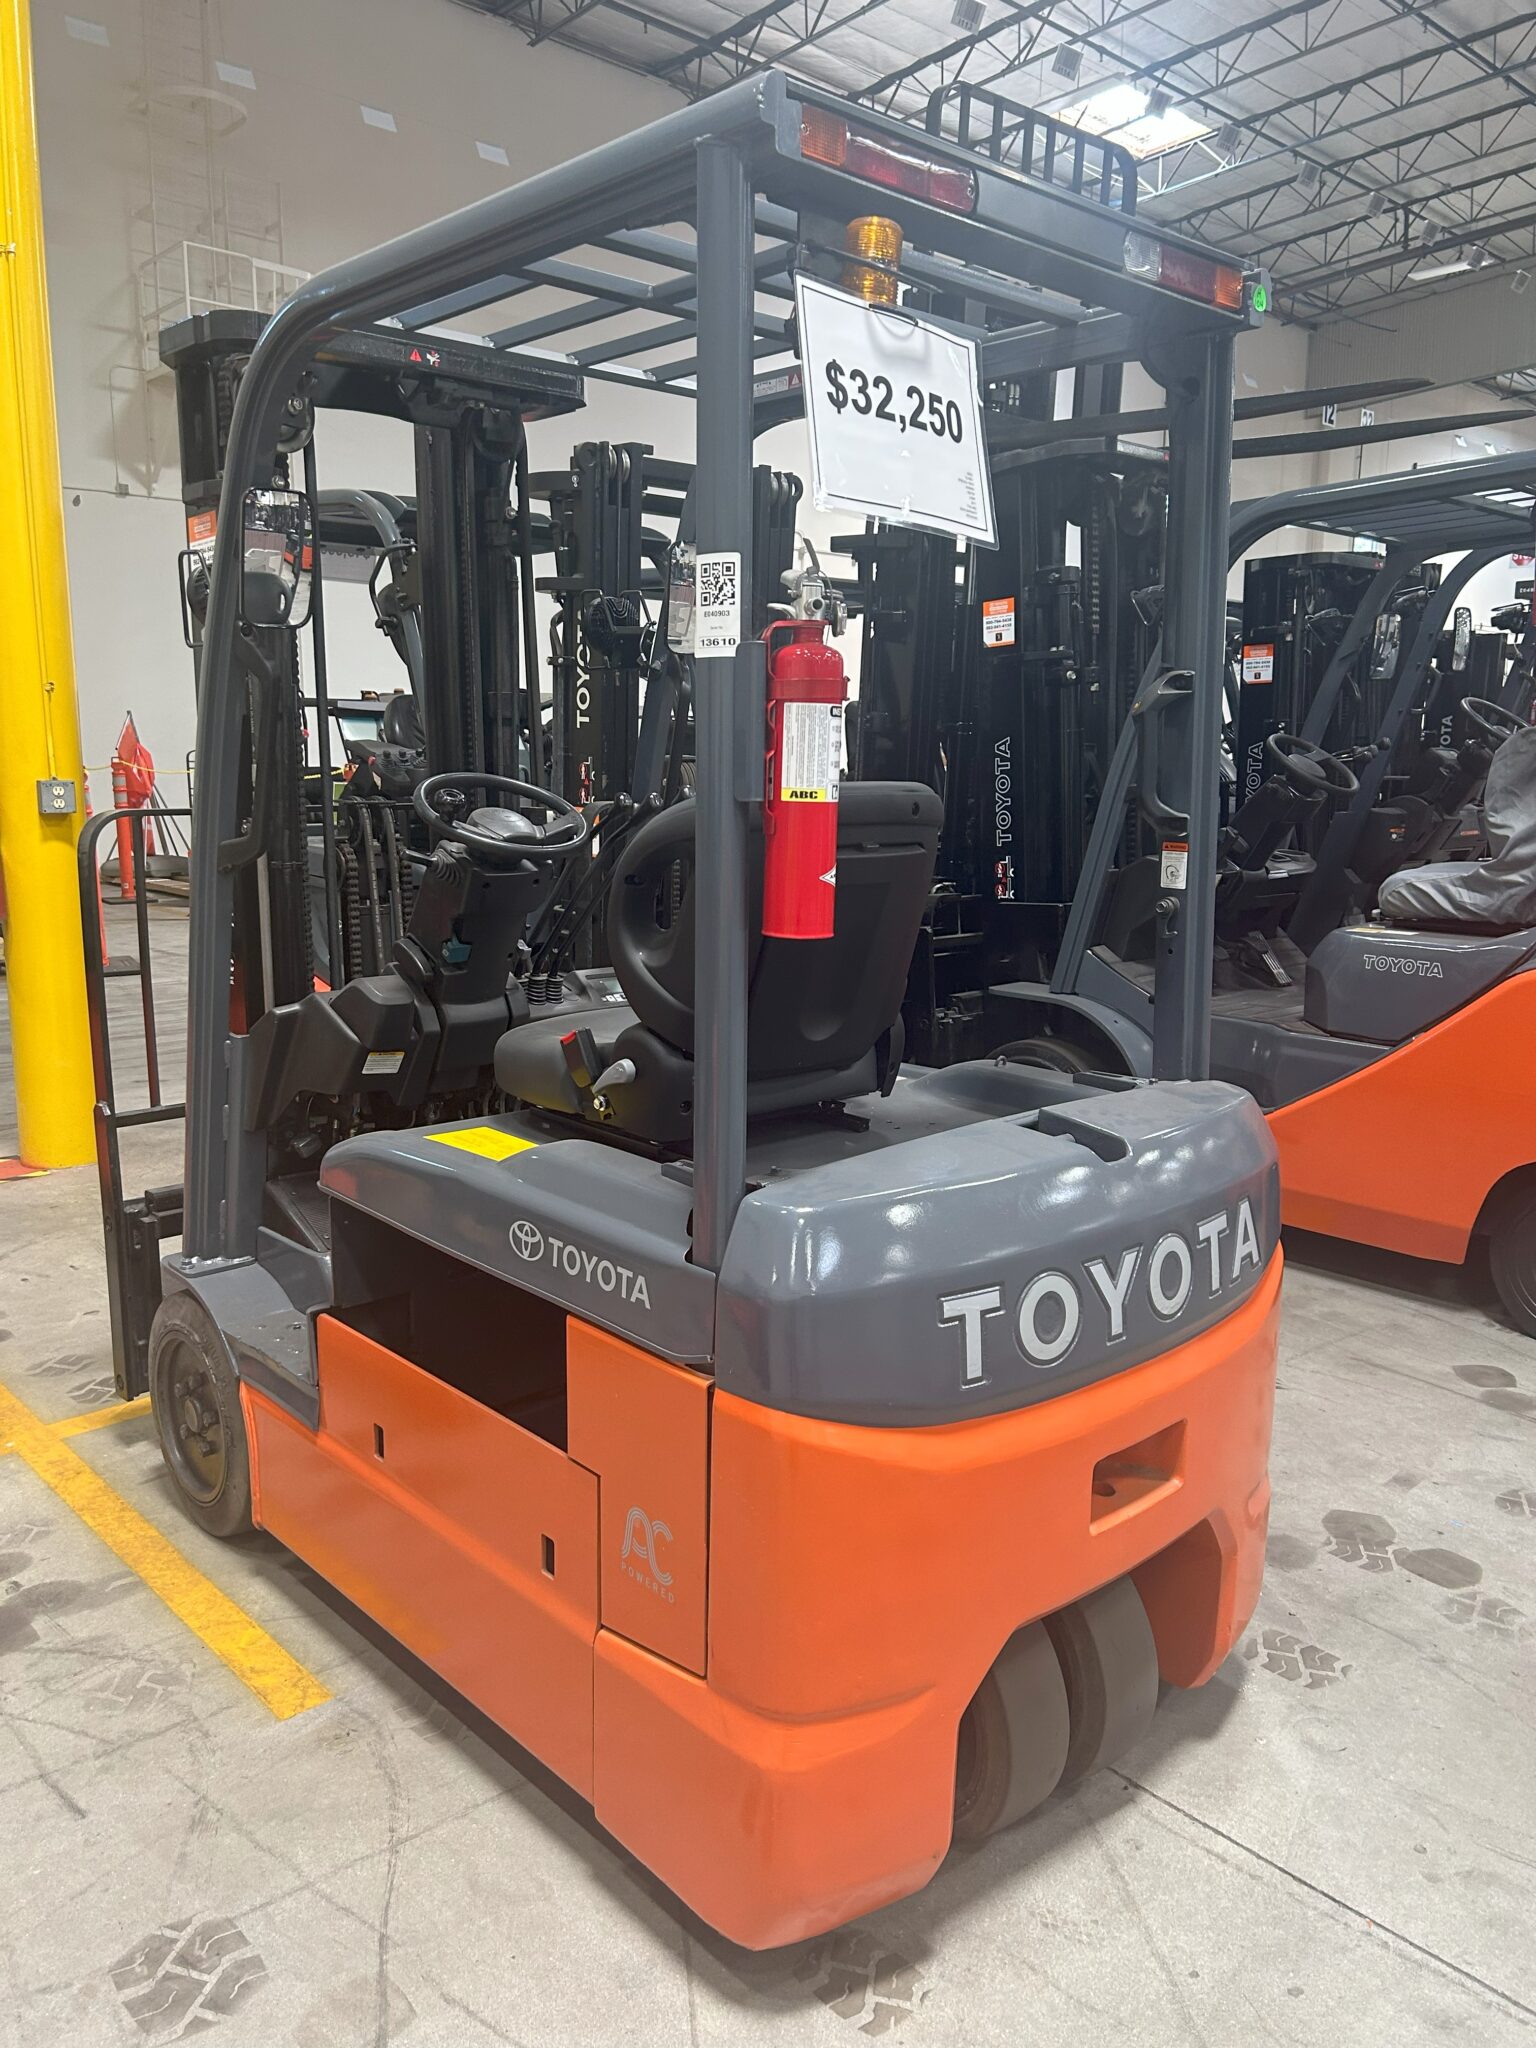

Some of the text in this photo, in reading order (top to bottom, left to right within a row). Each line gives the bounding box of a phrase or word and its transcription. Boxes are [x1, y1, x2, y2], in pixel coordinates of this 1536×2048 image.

[825, 358, 963, 444] $32,250
[700, 637, 737, 647] 13610
[703, 609, 731, 618] E040903
[789, 790, 819, 800] ABC
[995, 736, 1013, 847] TOYOTA
[1363, 954, 1443, 978] TOYOTA
[548, 1236, 651, 1310] TOYOTA
[939, 1198, 1262, 1386] TOYOTA
[621, 1506, 674, 1586] AC
[621, 1560, 675, 1604] POWERED
